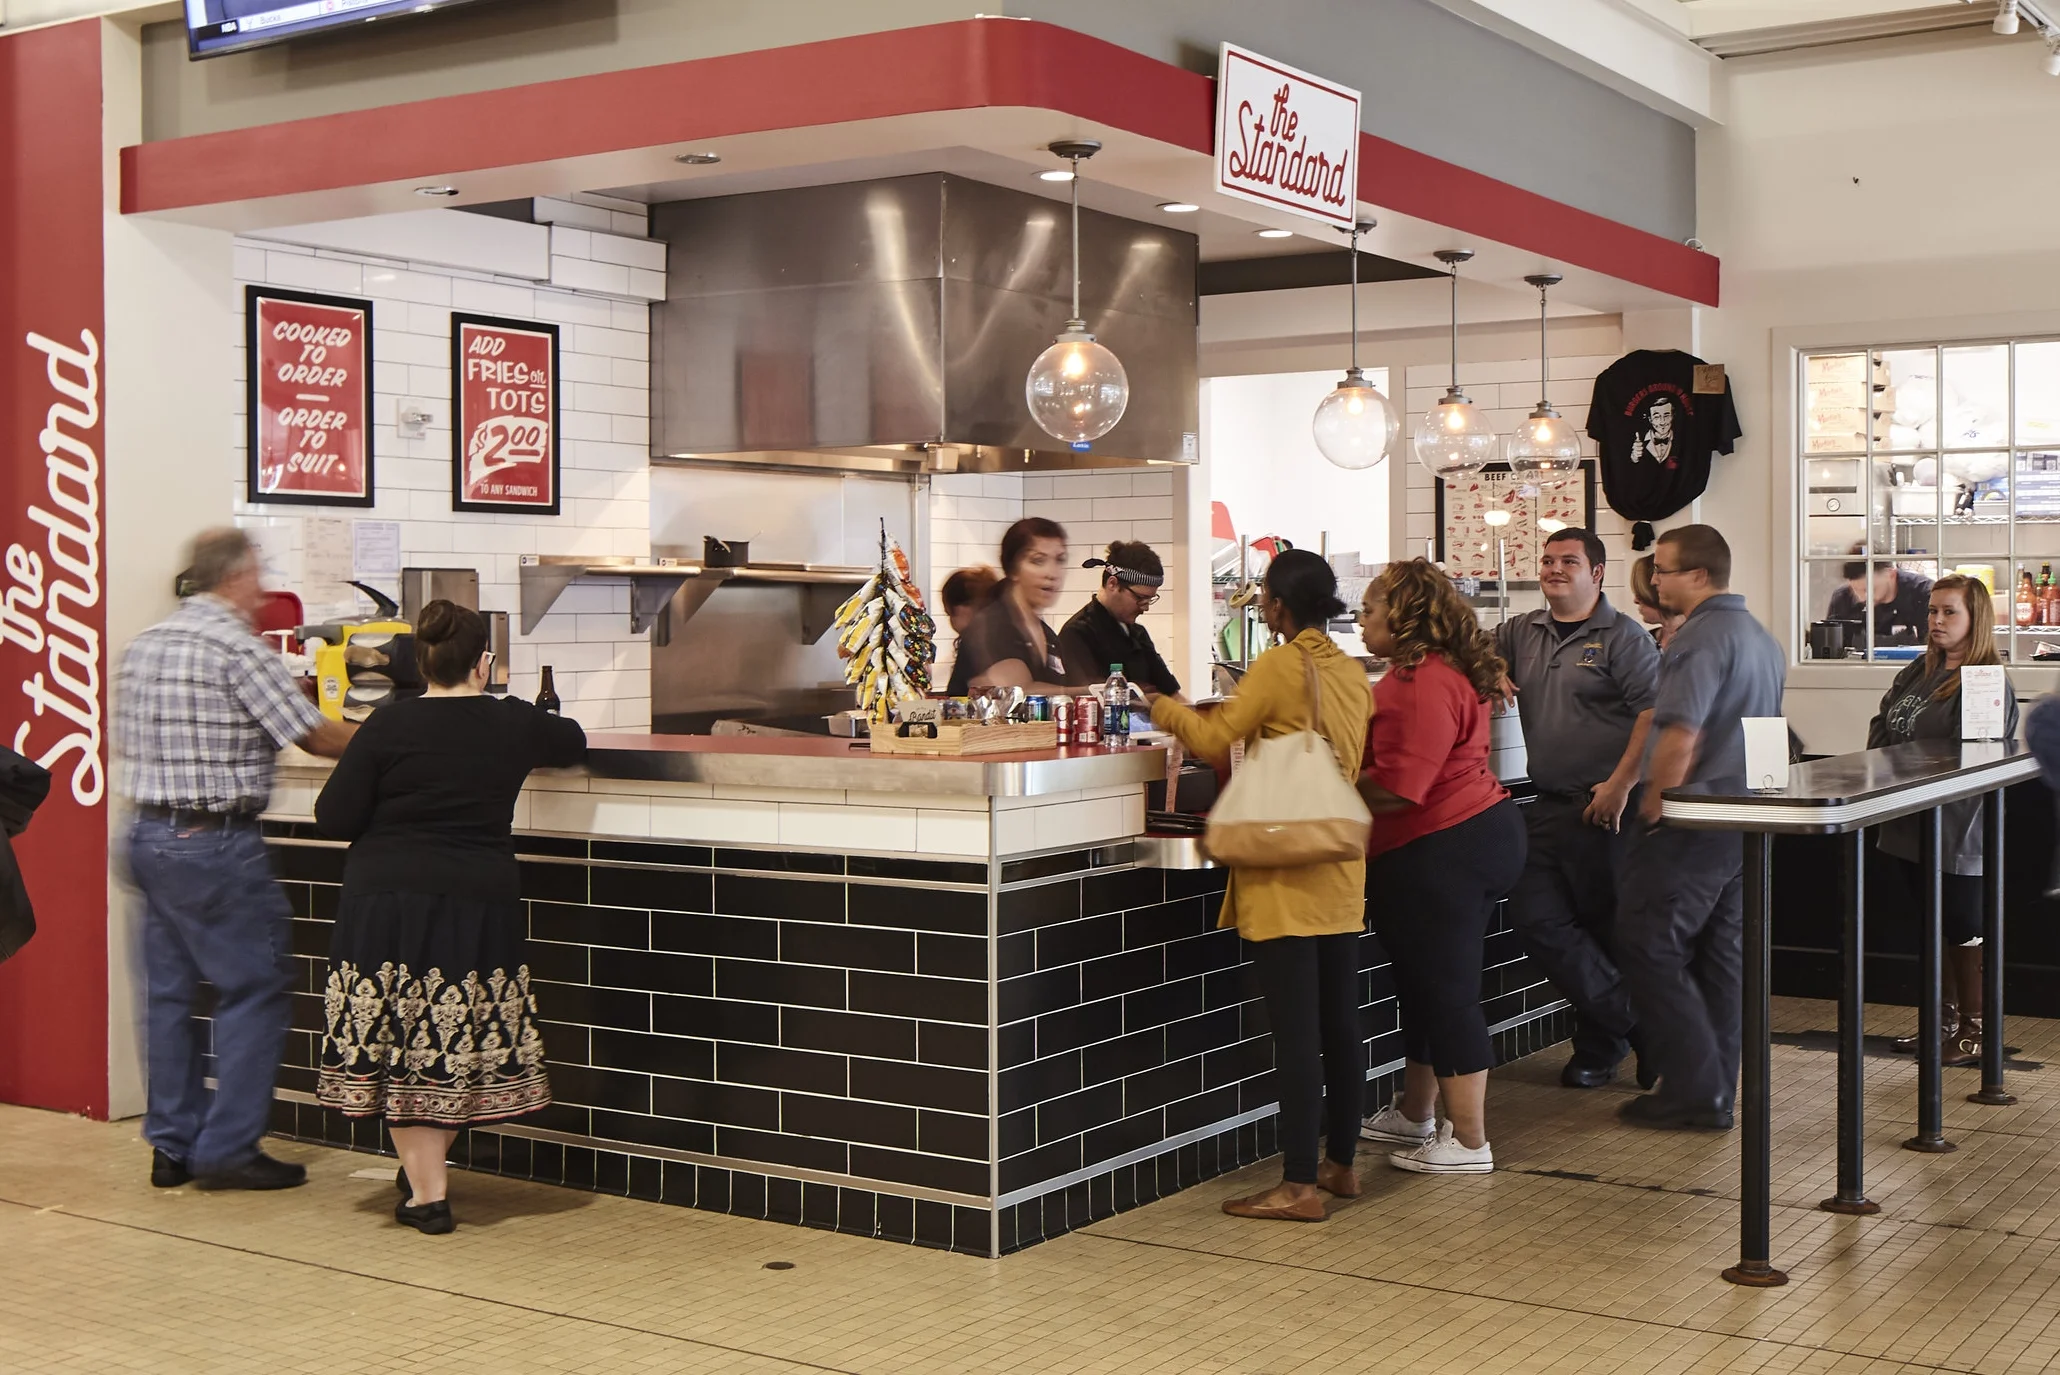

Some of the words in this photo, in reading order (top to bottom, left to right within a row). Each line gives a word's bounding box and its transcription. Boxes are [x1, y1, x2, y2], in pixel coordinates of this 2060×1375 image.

[1270, 83, 1298, 143] the
[1229, 100, 1348, 207] Standard
[273, 321, 352, 348] COOKED
[468, 335, 506, 357] ADD
[299, 344, 327, 364] TO
[277, 363, 348, 388] ORDER
[467, 358, 530, 385] FRIES
[486, 388, 546, 414] TOTS
[277, 407, 348, 431] ORDER
[299, 430, 327, 450] TO
[286, 452, 339, 475] SUIT
[1484, 472, 1507, 481] BEEF
[1510, 470, 1546, 481] CART
[480, 484, 489, 494] TO
[490, 484, 504, 495] ANY
[505, 485, 538, 497] SANDWICH
[14, 328, 104, 806] Standard
